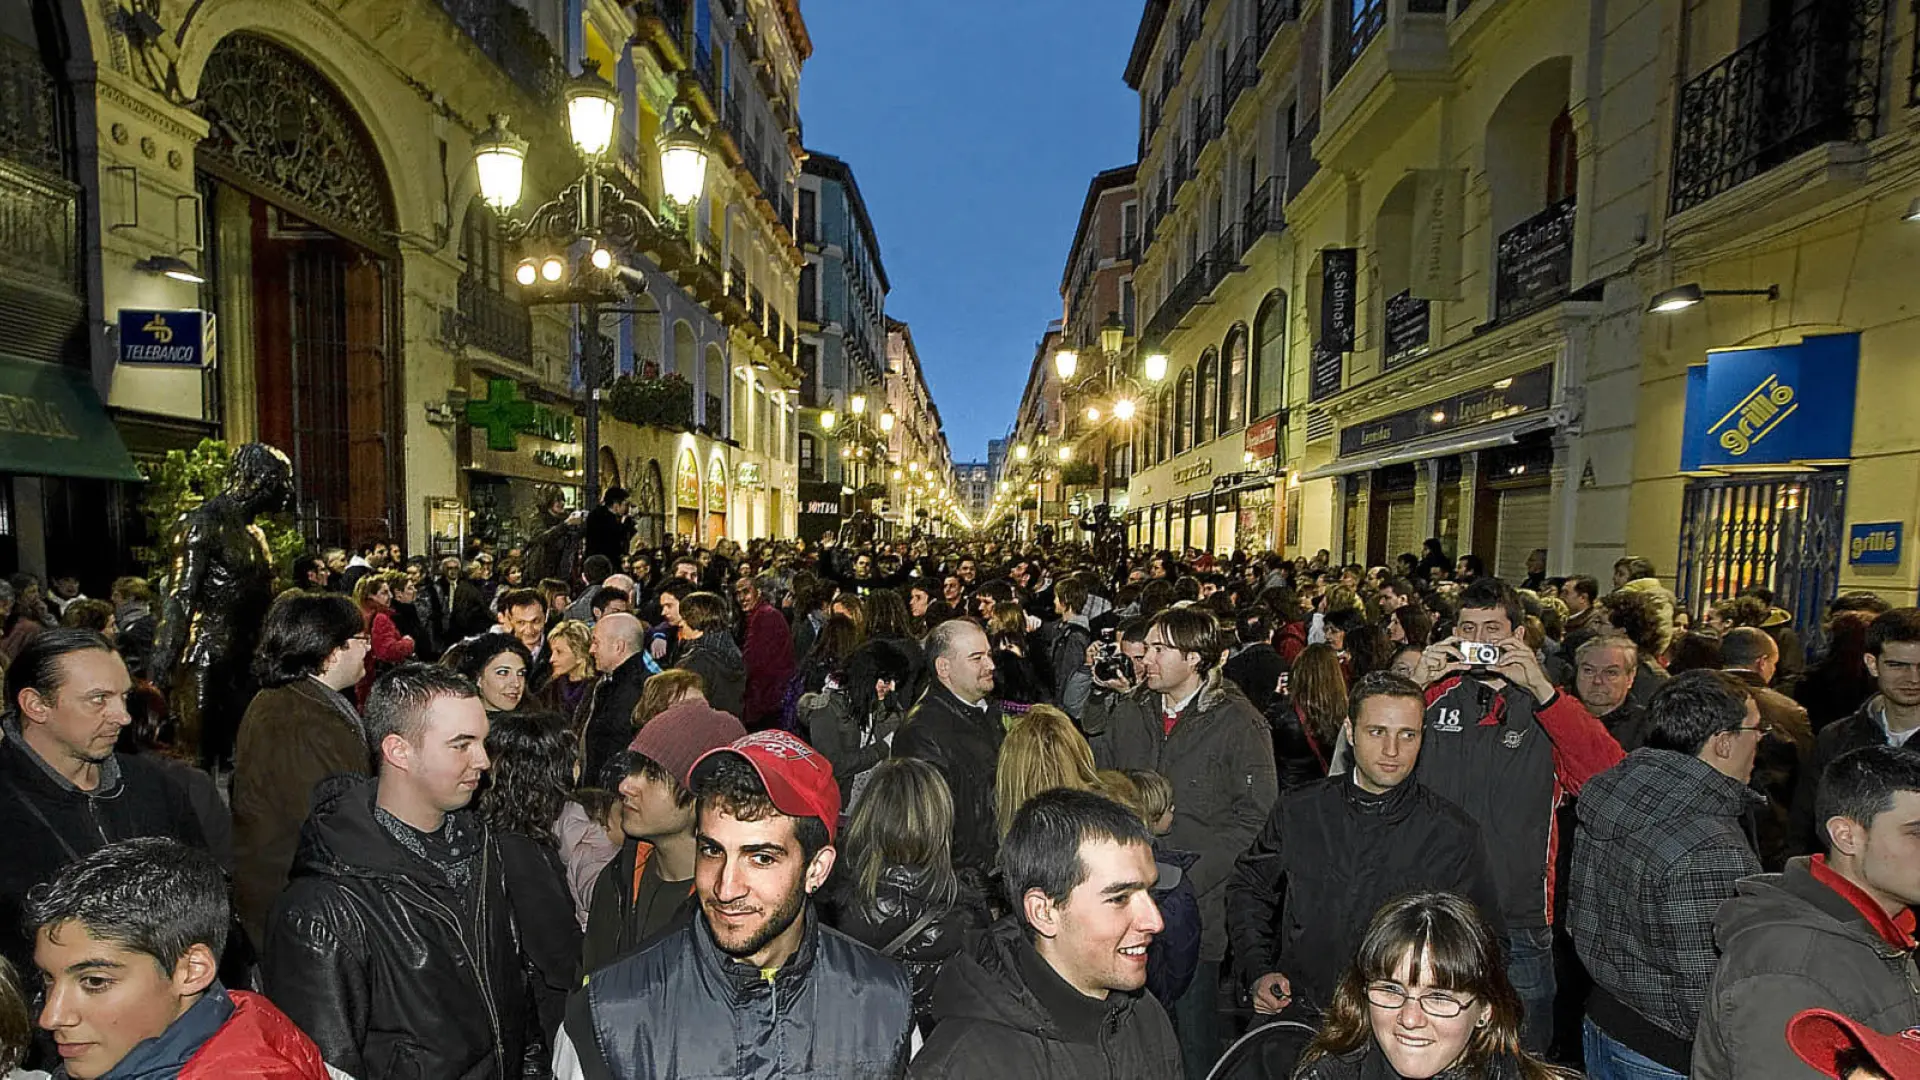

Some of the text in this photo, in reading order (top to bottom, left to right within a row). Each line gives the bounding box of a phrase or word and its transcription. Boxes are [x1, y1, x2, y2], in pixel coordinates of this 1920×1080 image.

[1333, 270, 1348, 329] Sabinas
[126, 344, 194, 362] TELEBANCO
[1438, 707, 1461, 726] 18
